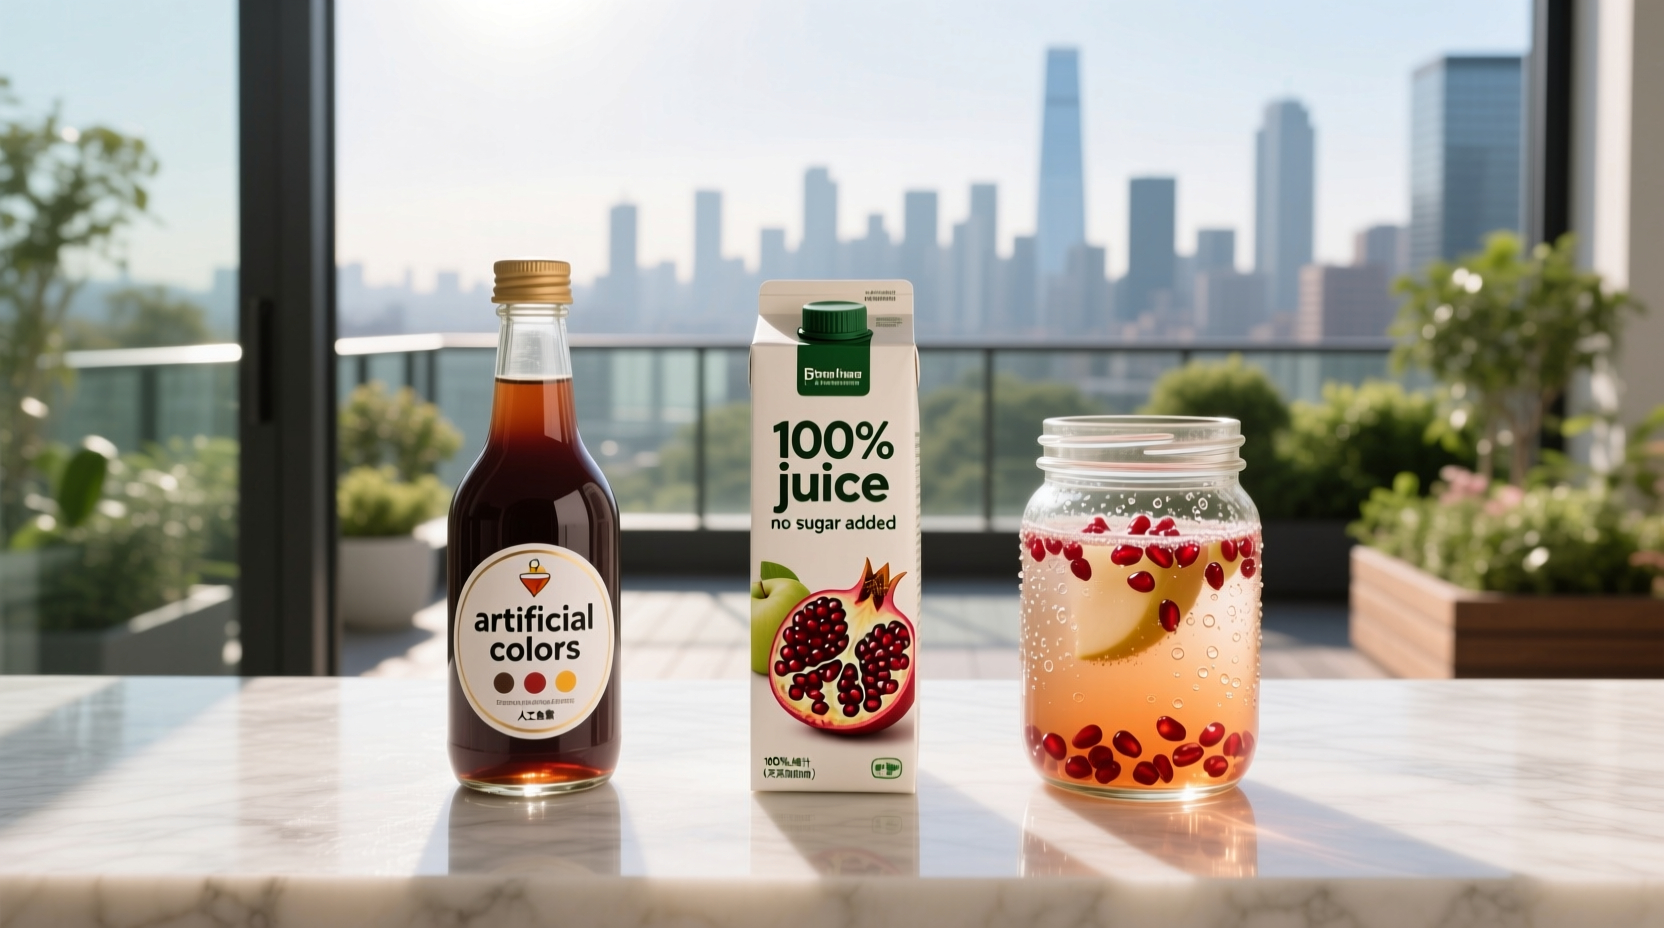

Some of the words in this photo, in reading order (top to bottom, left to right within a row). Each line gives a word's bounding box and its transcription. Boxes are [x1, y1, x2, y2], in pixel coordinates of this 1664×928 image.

[773, 420, 894, 460] 100%
[773, 461, 889, 514] juice
[771, 518, 791, 530] no
[796, 518, 841, 534] sugar
[845, 514, 896, 530] added
[474, 602, 593, 633] artificial
[490, 636, 580, 662] colors
